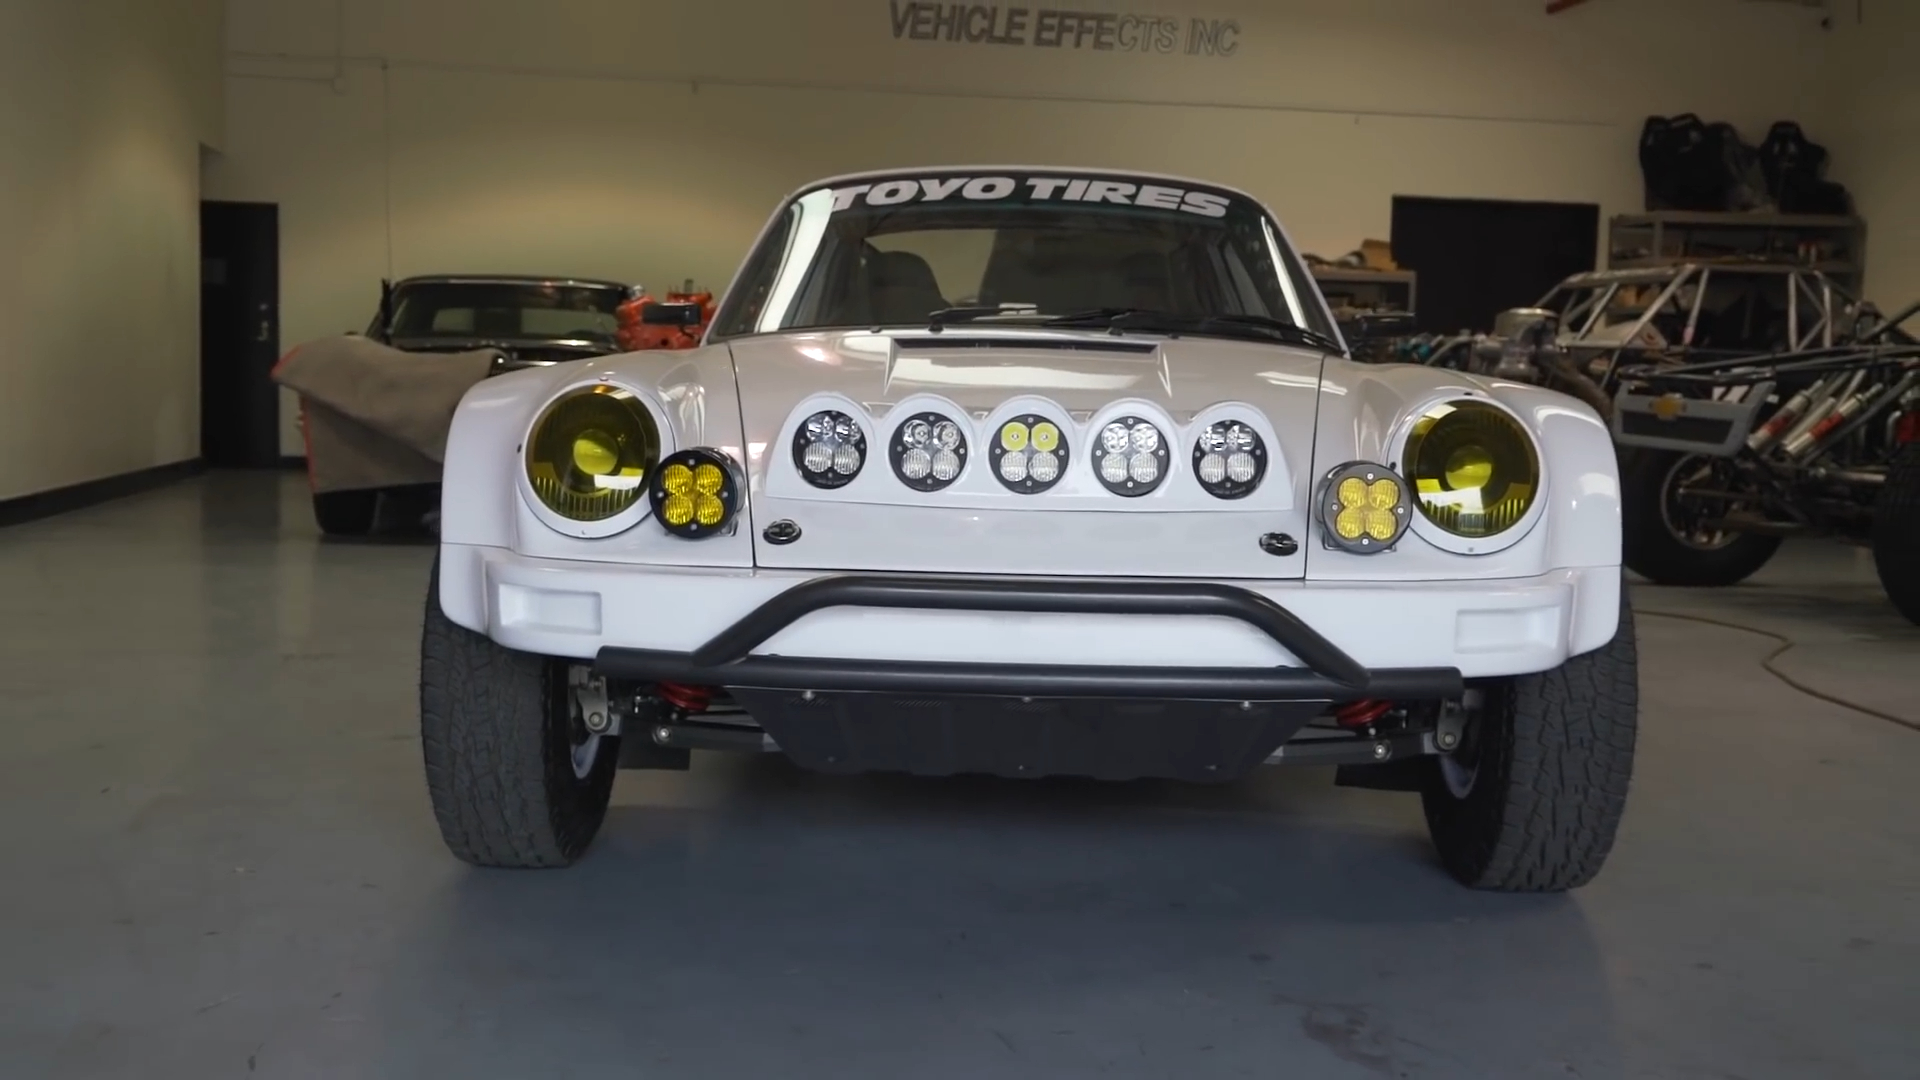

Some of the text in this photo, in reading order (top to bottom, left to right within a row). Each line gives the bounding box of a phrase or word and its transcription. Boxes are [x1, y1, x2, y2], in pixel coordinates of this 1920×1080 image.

[889, 0, 1241, 57] VEHICLE EFFECTS INC
[831, 176, 1231, 218] TOYO TIRES
